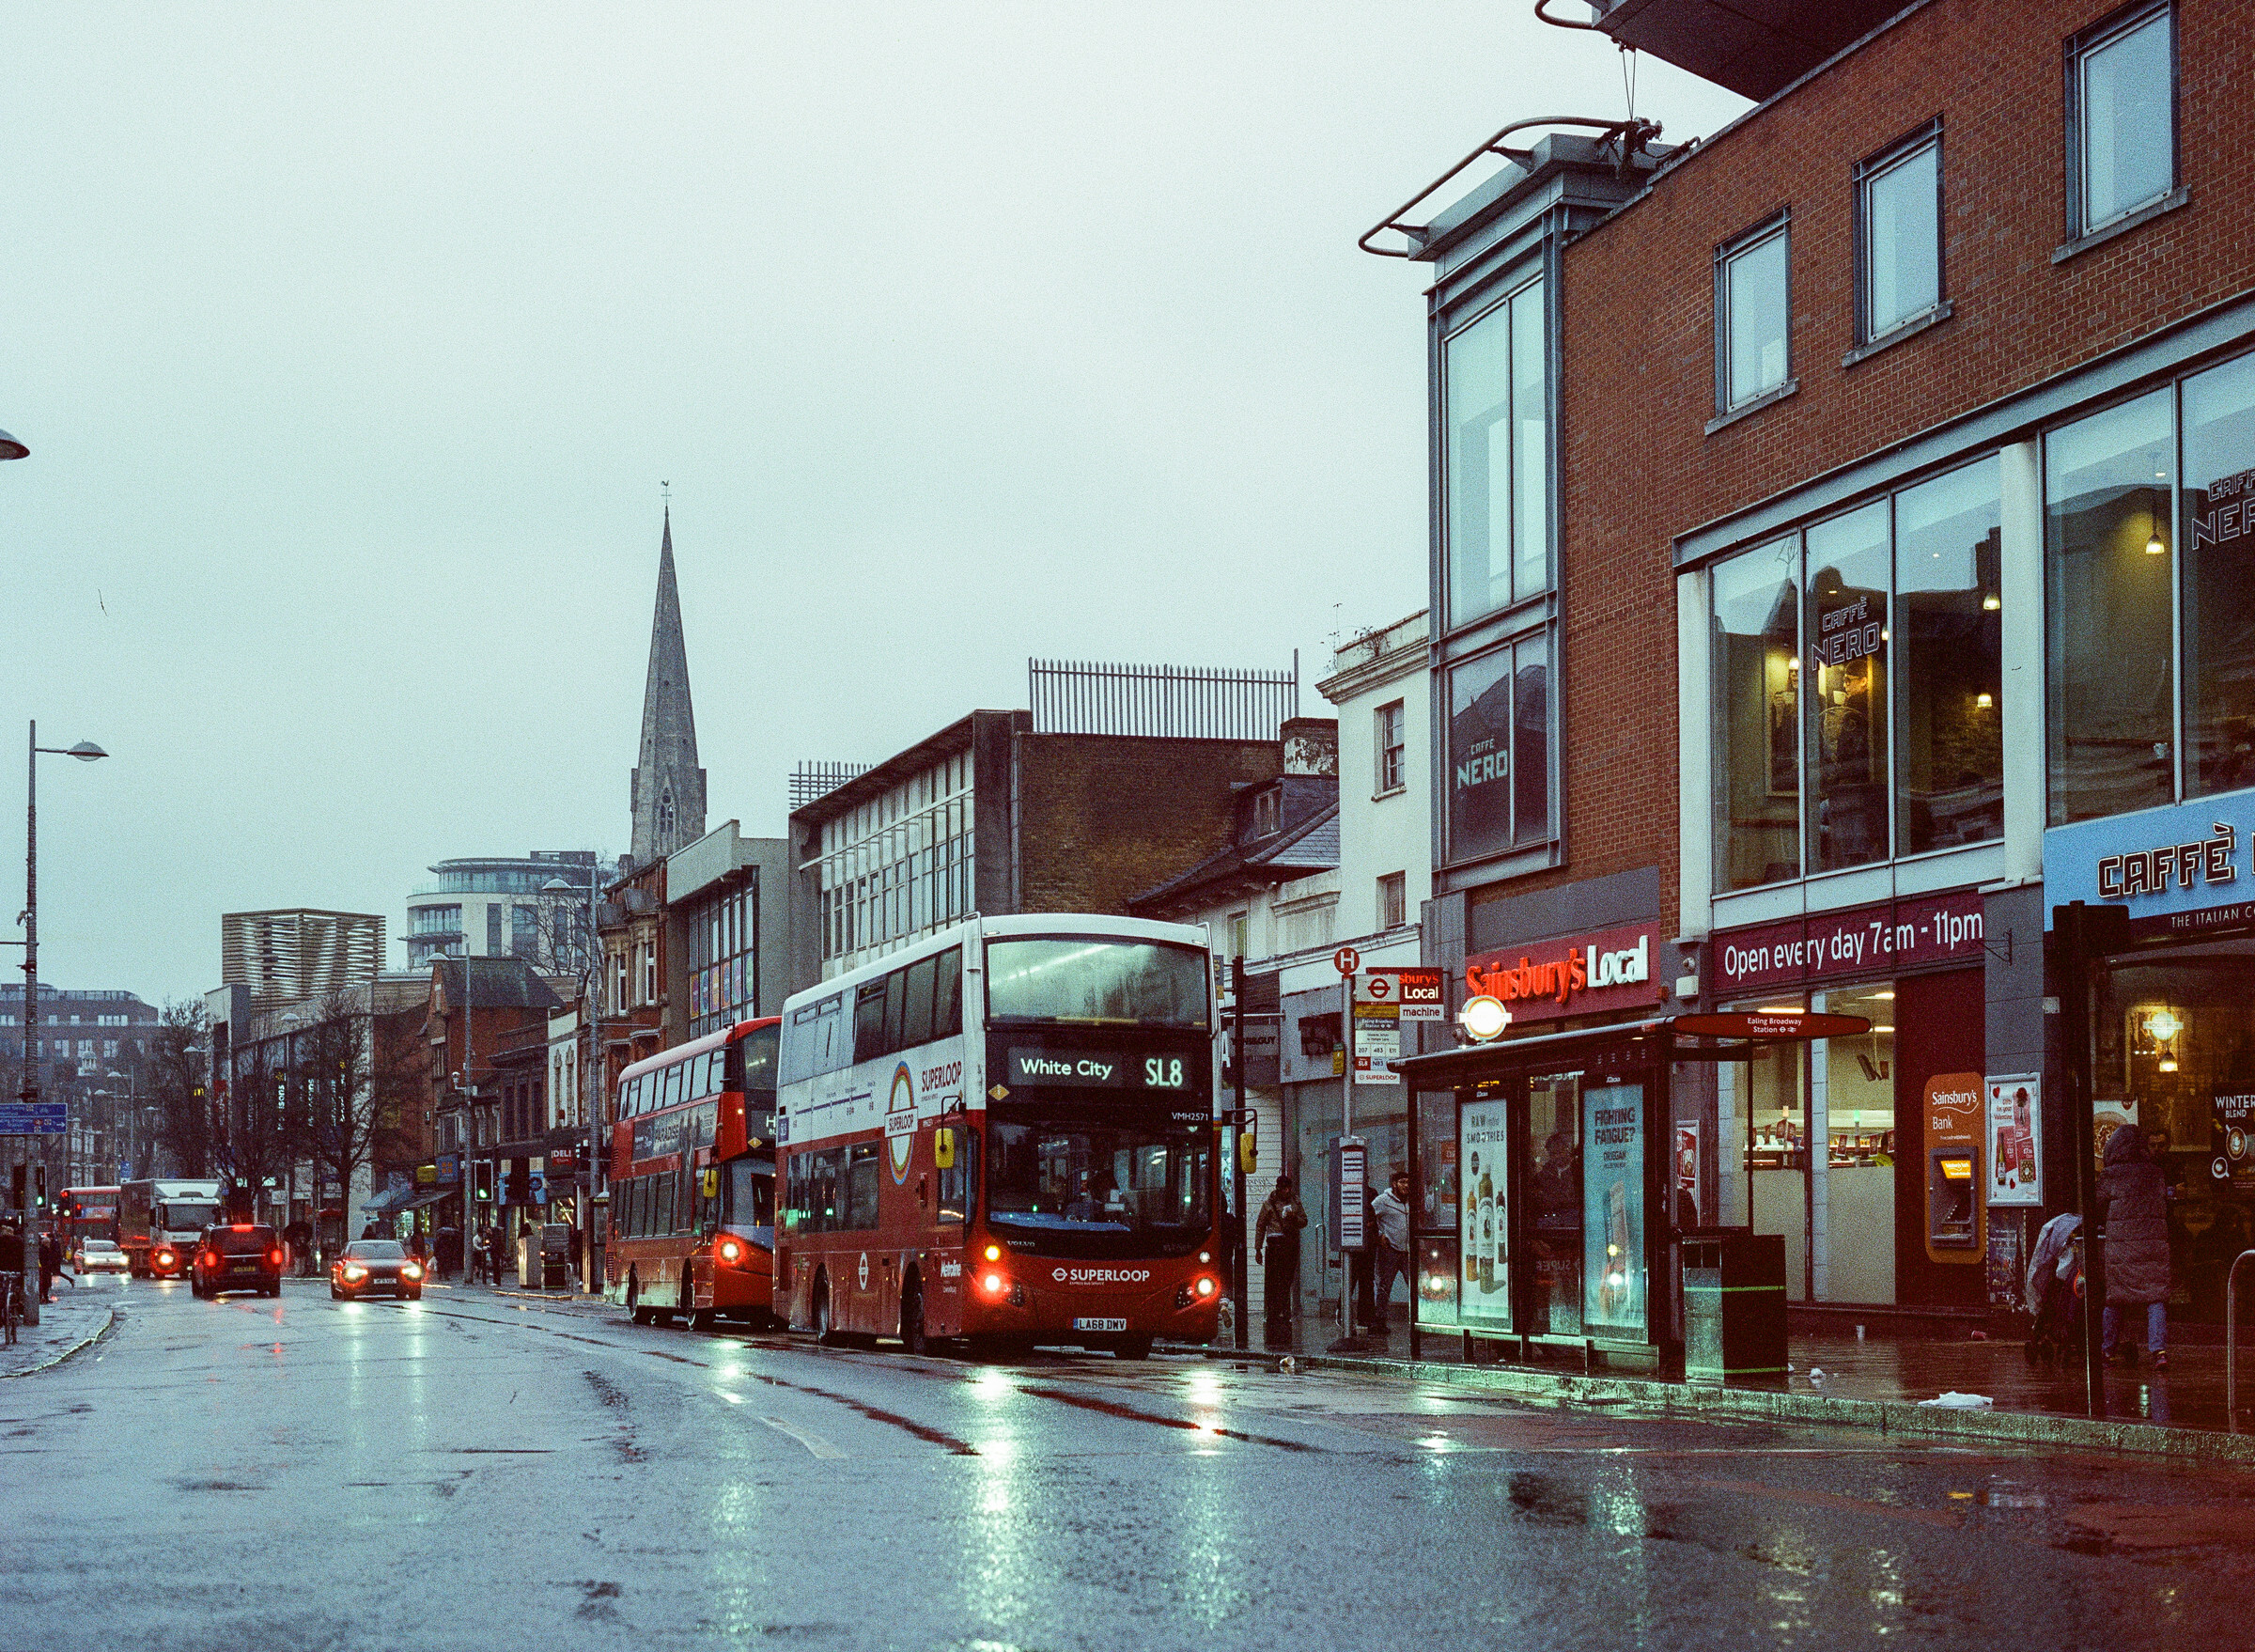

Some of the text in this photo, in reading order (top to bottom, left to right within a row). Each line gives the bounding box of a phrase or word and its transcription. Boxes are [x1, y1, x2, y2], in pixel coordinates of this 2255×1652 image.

[1823, 596, 1868, 632] CAFFÈ
[1812, 621, 1880, 672] NERO
[1457, 749, 1508, 790] NERO
[2098, 821, 2236, 899] CAFFÈ
[2171, 914, 2190, 928] THE
[2196, 907, 2239, 925] ITALIAN
[1724, 944, 1769, 981] Open
[1774, 938, 1826, 970] every
[1831, 927, 1864, 965] day
[1870, 921, 1915, 954] 7am
[1934, 911, 1983, 950] 11pm
[1340, 951, 1355, 969] H
[1466, 935, 1649, 1003] Sainsbury's Local
[1404, 986, 1439, 999] Local
[1403, 1007, 1440, 1017] machine
[1747, 1017, 1802, 1026] Ealing Broadway
[922, 1060, 962, 1093] SUPERLOOP
[1020, 1058, 1112, 1081] White City
[1145, 1058, 1183, 1086] SL8
[1932, 1090, 1978, 1106] Sainsbury's
[2215, 1094, 2255, 1109] WINTER
[1171, 1112, 1209, 1121] VMH2571
[1470, 1114, 1485, 1127] RAW
[1594, 1107, 1636, 1127] FIGHTING
[1932, 1115, 1953, 1130] Bank
[2225, 1109, 2247, 1118] BLEND
[889, 1114, 914, 1132] SUPERLOOP
[1467, 1130, 1504, 1144] SMOOTHIES
[1594, 1127, 1635, 1145] FATIGUE?
[1069, 1269, 1150, 1282] SUPERLOOP
[1080, 1318, 1126, 1330] LA68 DWV
